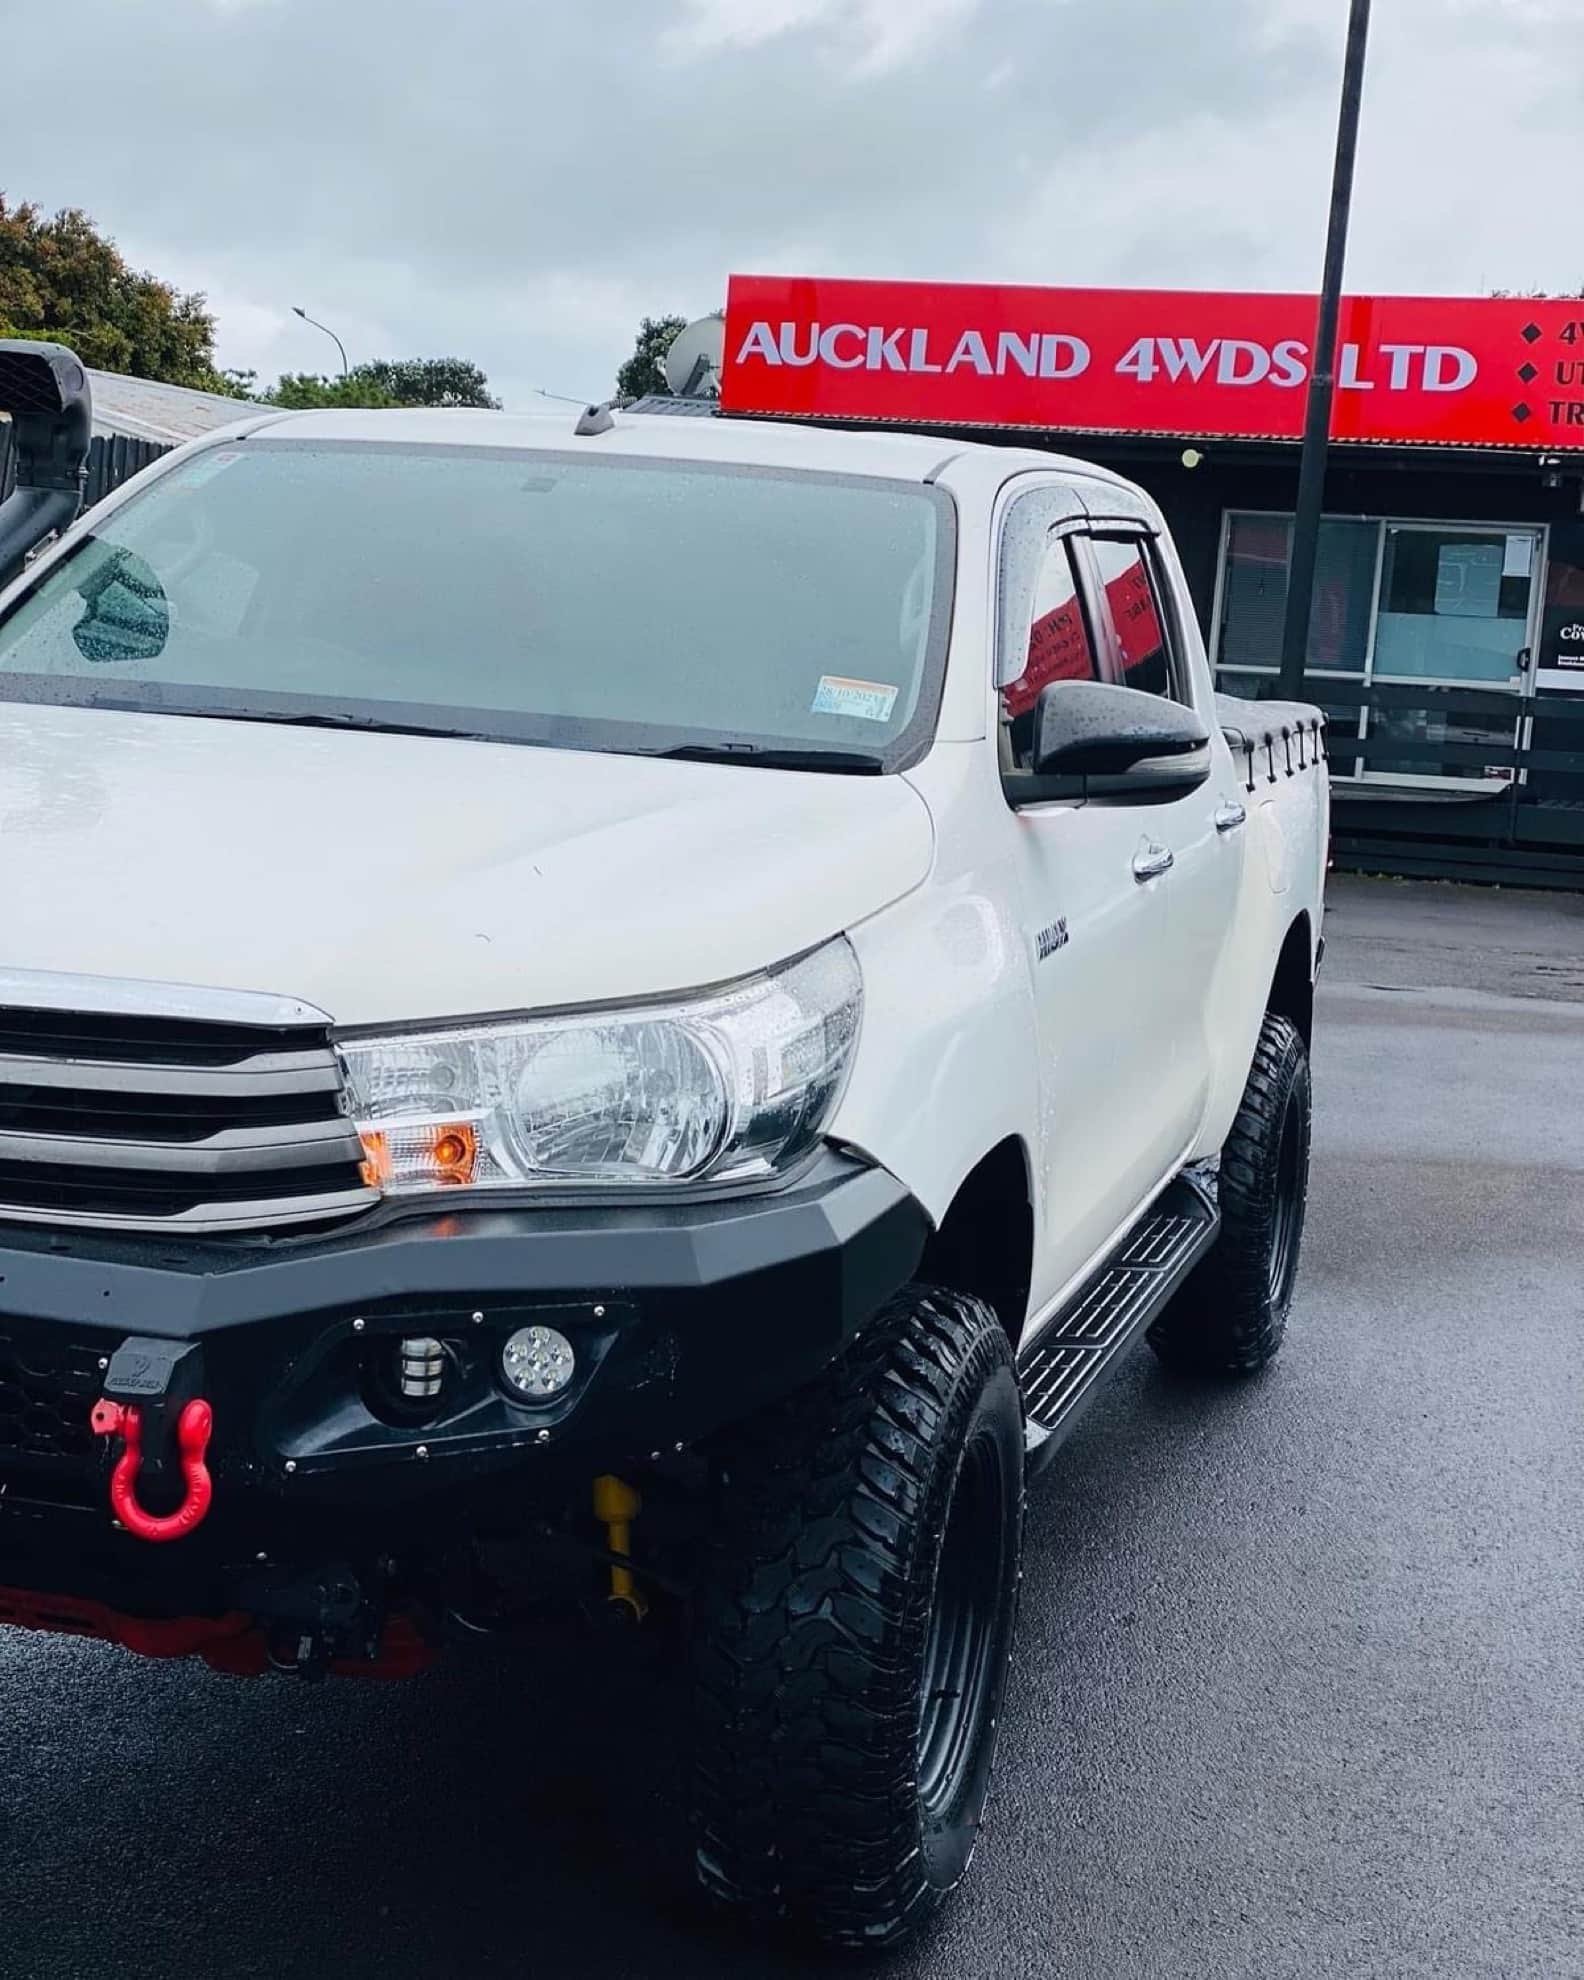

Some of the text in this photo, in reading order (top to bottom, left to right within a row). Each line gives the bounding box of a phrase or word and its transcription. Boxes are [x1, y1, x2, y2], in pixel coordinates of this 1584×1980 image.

[1560, 321, 1584, 345] 4
[735, 321, 1478, 392] AUCKLAND 4WDS LTD
[1548, 401, 1584, 425] TR
